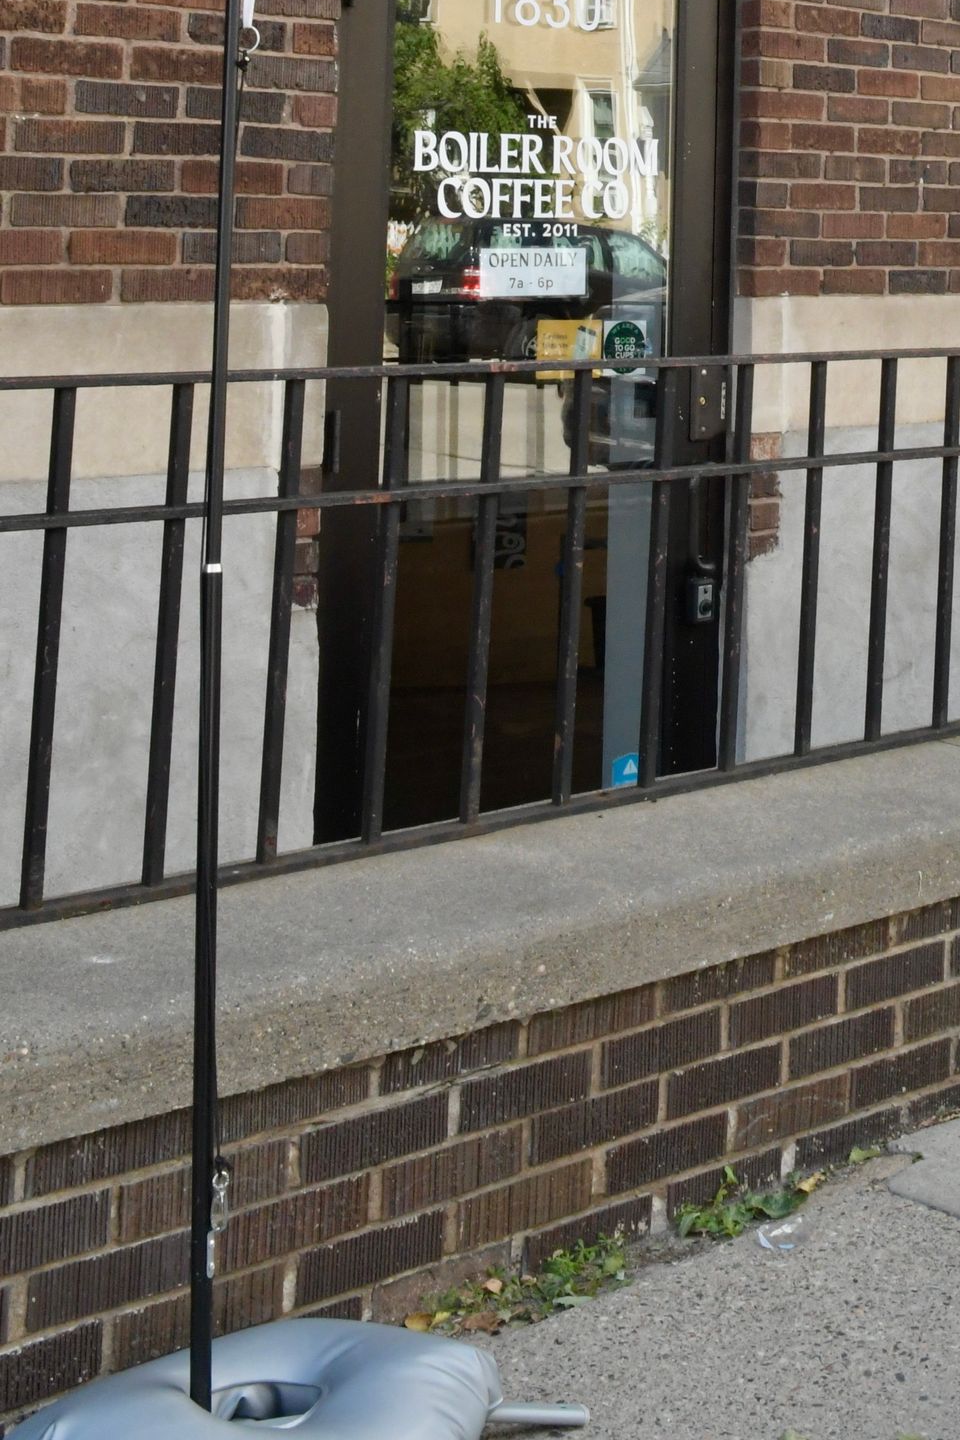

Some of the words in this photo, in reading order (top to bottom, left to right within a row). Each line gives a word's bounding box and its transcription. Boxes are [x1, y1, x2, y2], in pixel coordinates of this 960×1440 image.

[527, 114, 558, 129] THE
[413, 130, 547, 174] BOILER
[552, 135, 659, 176] ROOM
[437, 177, 576, 219] COFFEE
[502, 223, 536, 237] EST.
[542, 223, 578, 237] 2011
[488, 252, 529, 268] OPEN
[534, 252, 577, 267] DAILY
[509, 277, 524, 289] 7a
[537, 276, 554, 290] 6p
[614, 336, 636, 345] GOOD
[614, 344, 623, 352] TO
[624, 344, 636, 352] GO
[615, 351, 635, 359] CUPS
